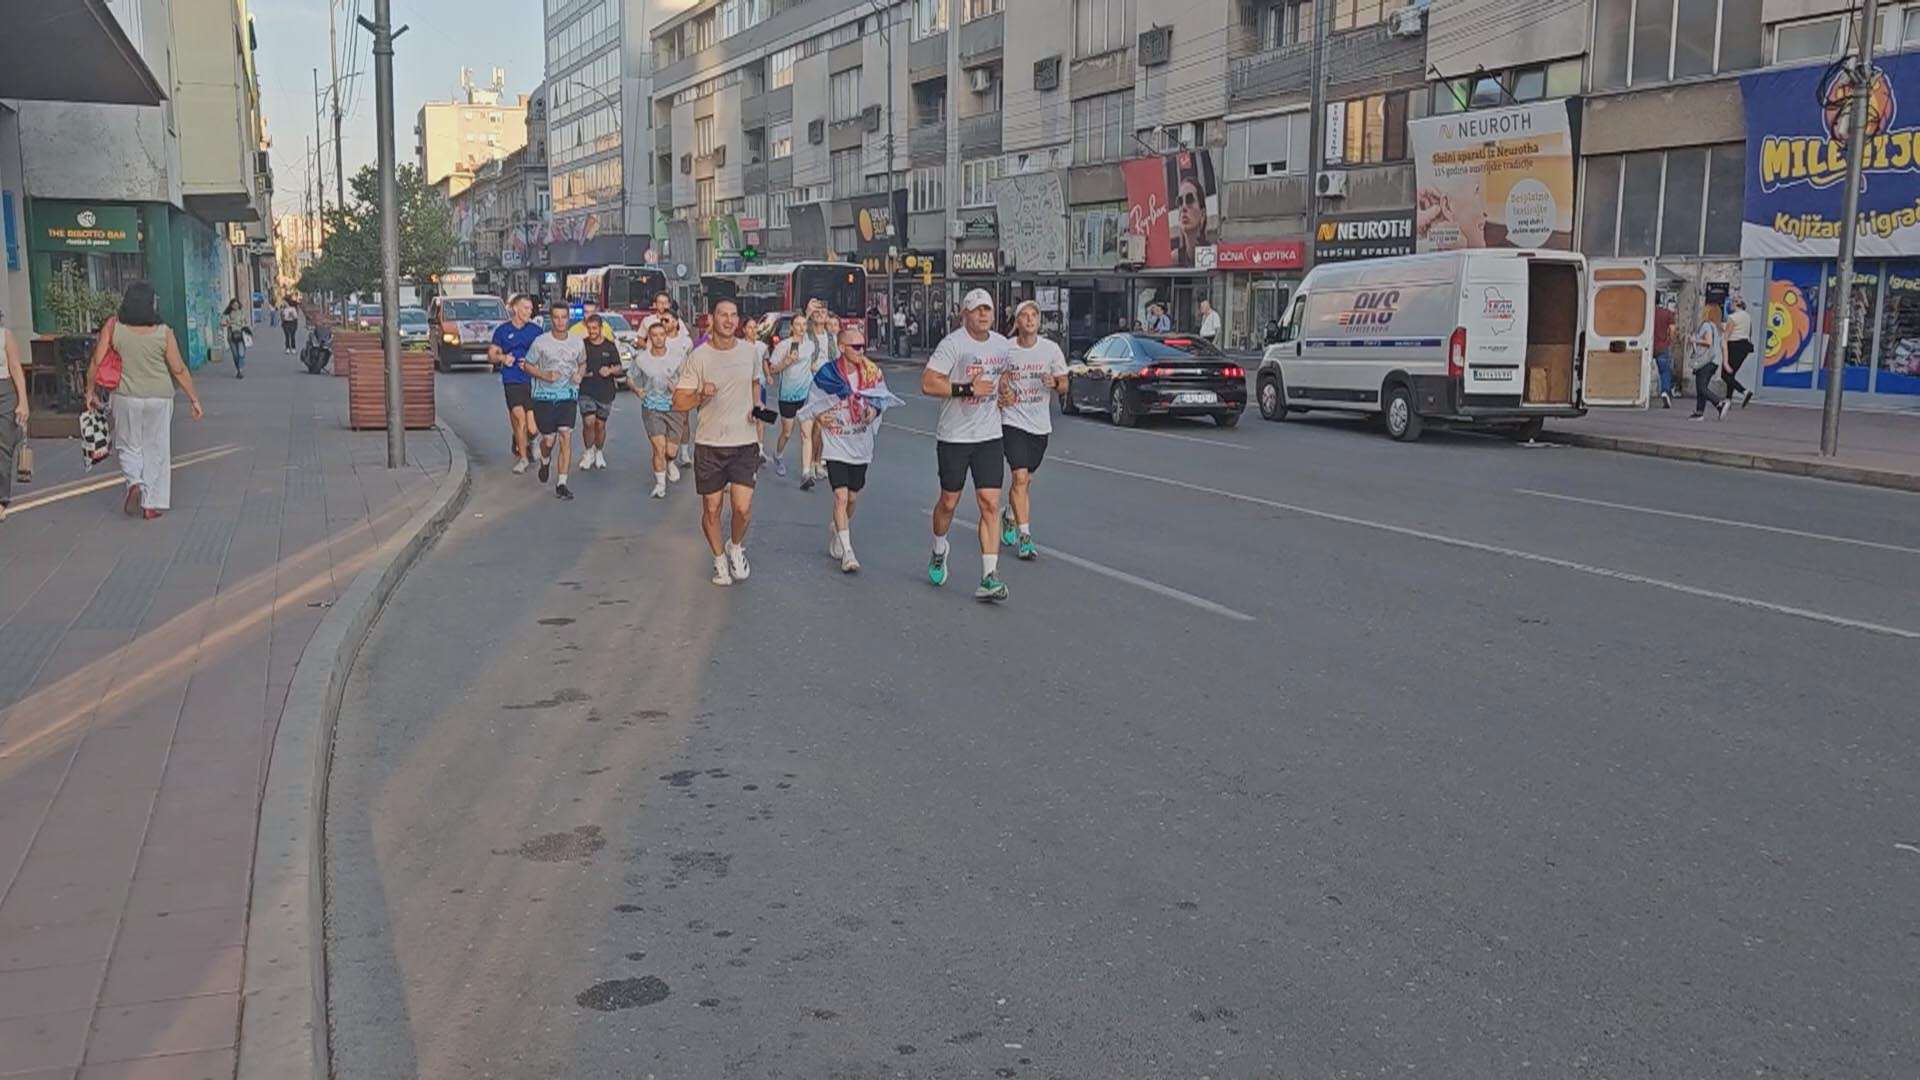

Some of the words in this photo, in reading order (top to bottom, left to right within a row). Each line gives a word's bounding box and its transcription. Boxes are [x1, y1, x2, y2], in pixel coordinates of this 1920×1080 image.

[1458, 112, 1531, 138] NEUROTH
[1497, 142, 1539, 157] Neurotha
[48, 229, 65, 238] THE
[107, 230, 126, 239] BAR
[1337, 219, 1412, 241] NEUROTH
[1775, 212, 1844, 242] Knjižar
[961, 251, 995, 270] PEKARA
[1263, 249, 1296, 260] OPTIKA
